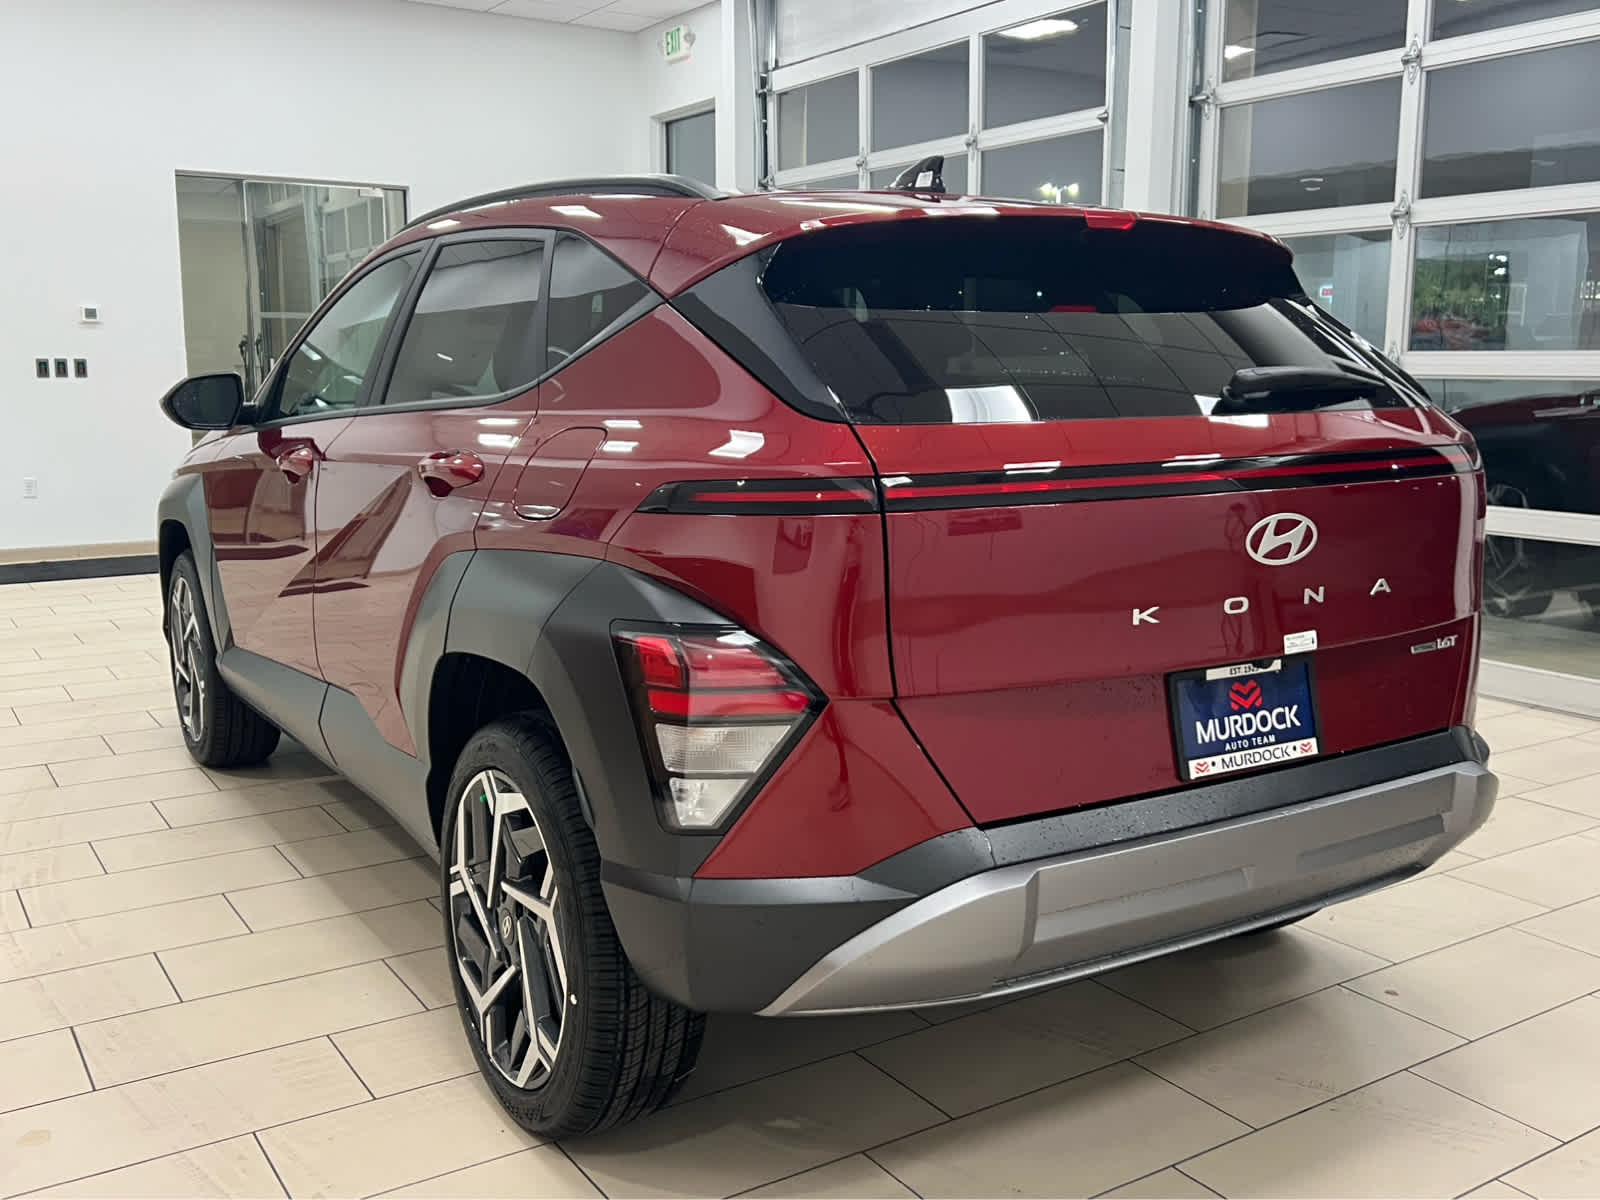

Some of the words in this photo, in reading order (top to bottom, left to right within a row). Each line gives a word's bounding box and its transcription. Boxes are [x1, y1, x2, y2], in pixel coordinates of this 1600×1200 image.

[665, 27, 681, 56] EXIT
[1195, 705, 1301, 744] MURDOCK
[1225, 741, 1249, 751] AUTO
[1251, 734, 1276, 746] TEAM
[1221, 745, 1290, 769] MURDOCK
